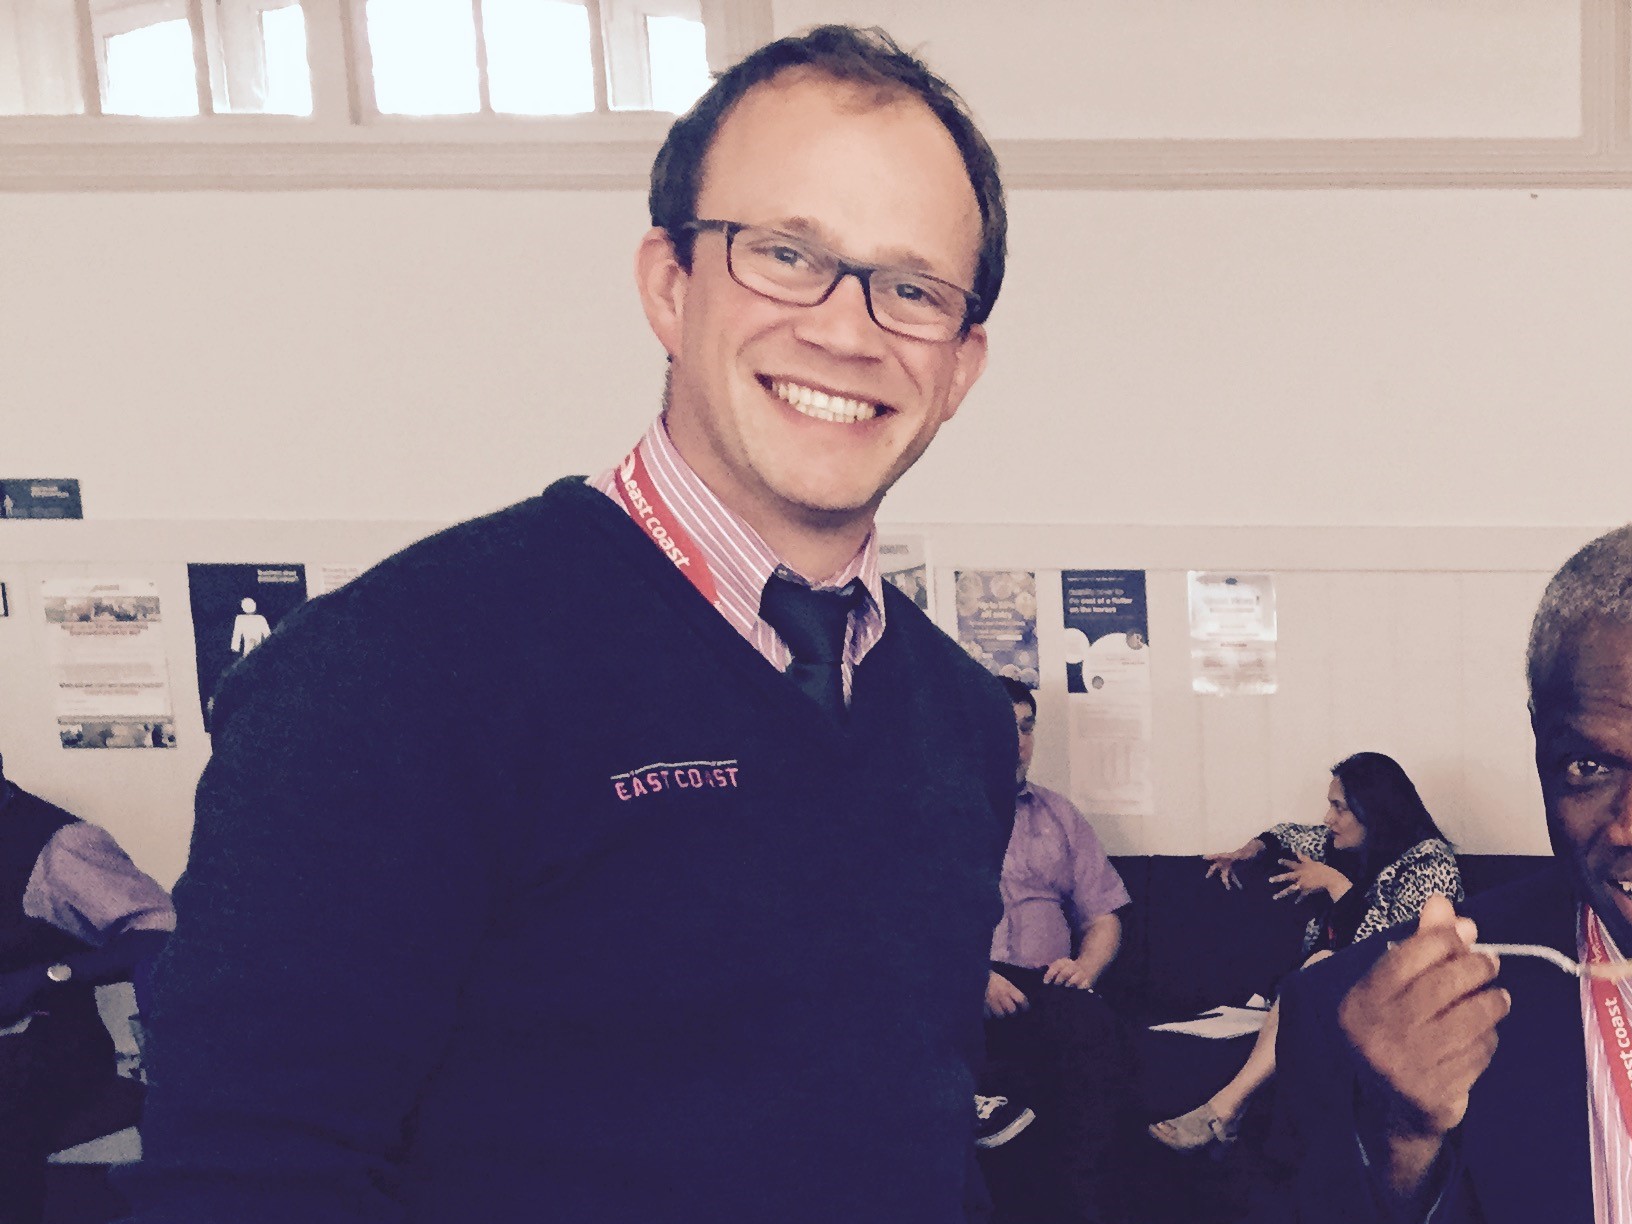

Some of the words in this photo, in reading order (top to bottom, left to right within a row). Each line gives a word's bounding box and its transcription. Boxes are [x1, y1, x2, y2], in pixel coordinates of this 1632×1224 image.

[624, 479, 653, 519] east
[646, 516, 691, 568] coast
[1604, 996, 1630, 1049] coast
